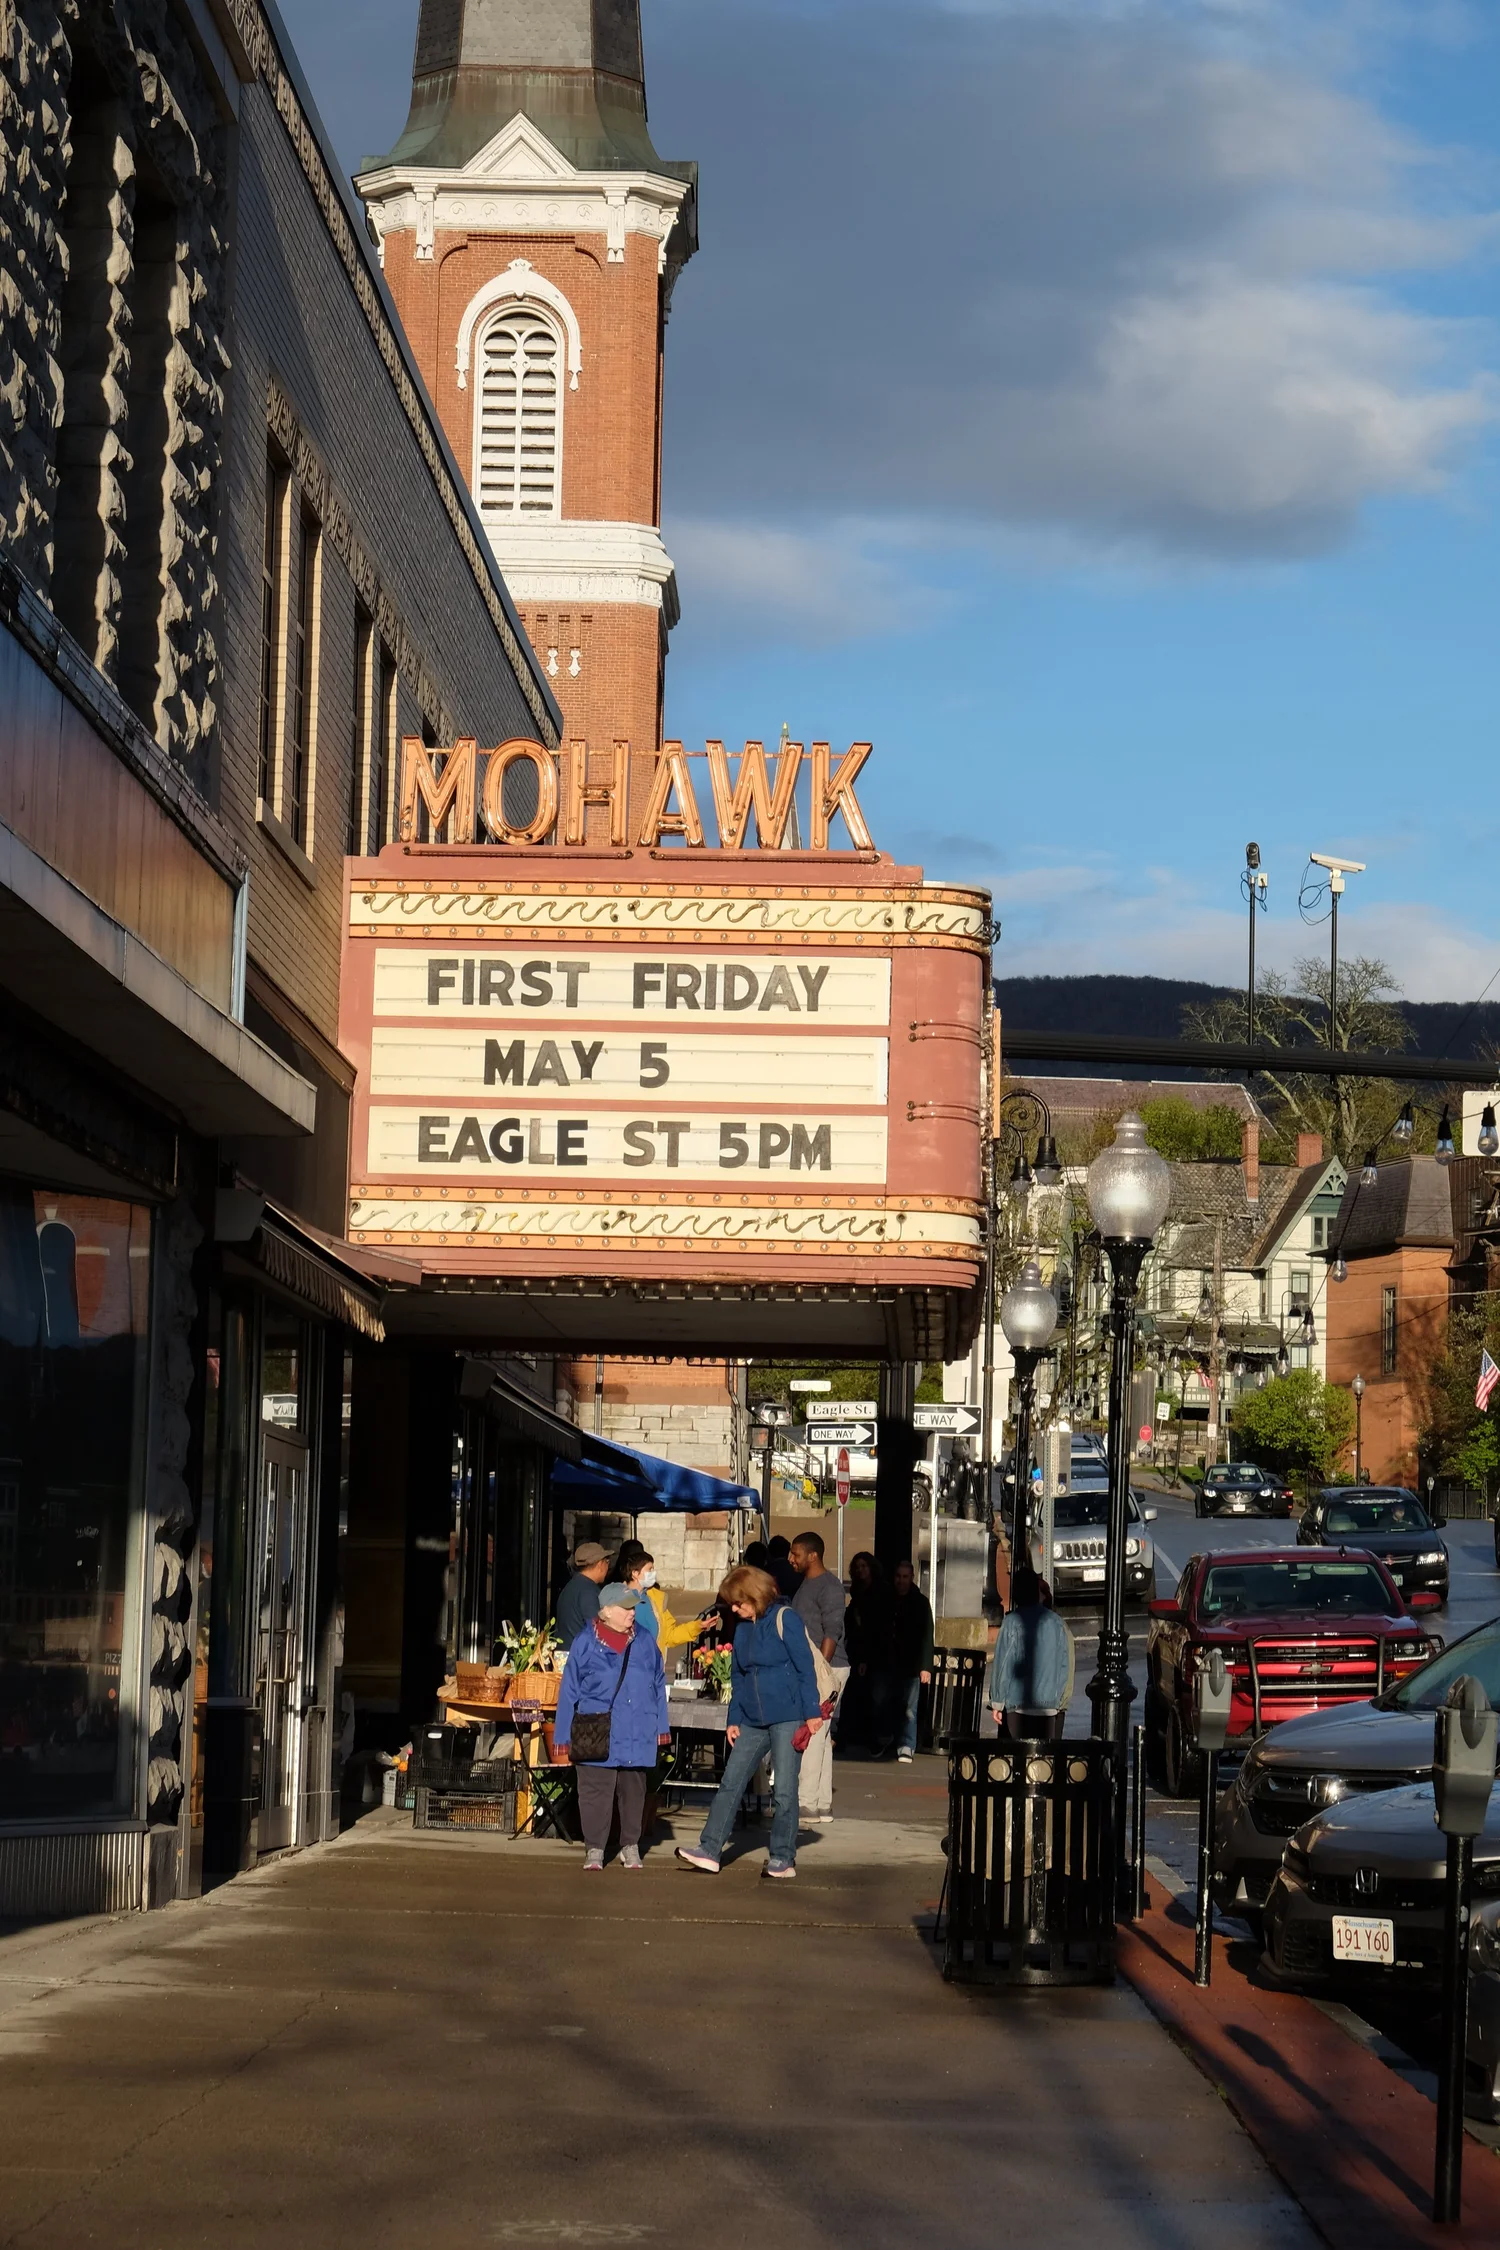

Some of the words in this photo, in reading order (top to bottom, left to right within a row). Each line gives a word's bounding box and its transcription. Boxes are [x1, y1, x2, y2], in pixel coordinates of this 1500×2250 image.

[400, 735, 877, 850] MOHAWK
[427, 958, 590, 1008] FIRST
[632, 962, 830, 1012] FRIDAY
[483, 1038, 605, 1087] MAY
[639, 1042, 671, 1089] 5
[417, 1115, 589, 1166] EAGLE
[622, 1120, 691, 1168] ST
[718, 1122, 832, 1171] 5PM
[812, 1404, 850, 1416] Eagle
[854, 1404, 872, 1415] St.
[914, 1414, 926, 1426] NE
[930, 1415, 955, 1426] WAY
[813, 1430, 833, 1439] ONE
[835, 1430, 855, 1439] WAY
[1337, 1928, 1361, 1950] 191
[1365, 1929, 1390, 1952] Y60
